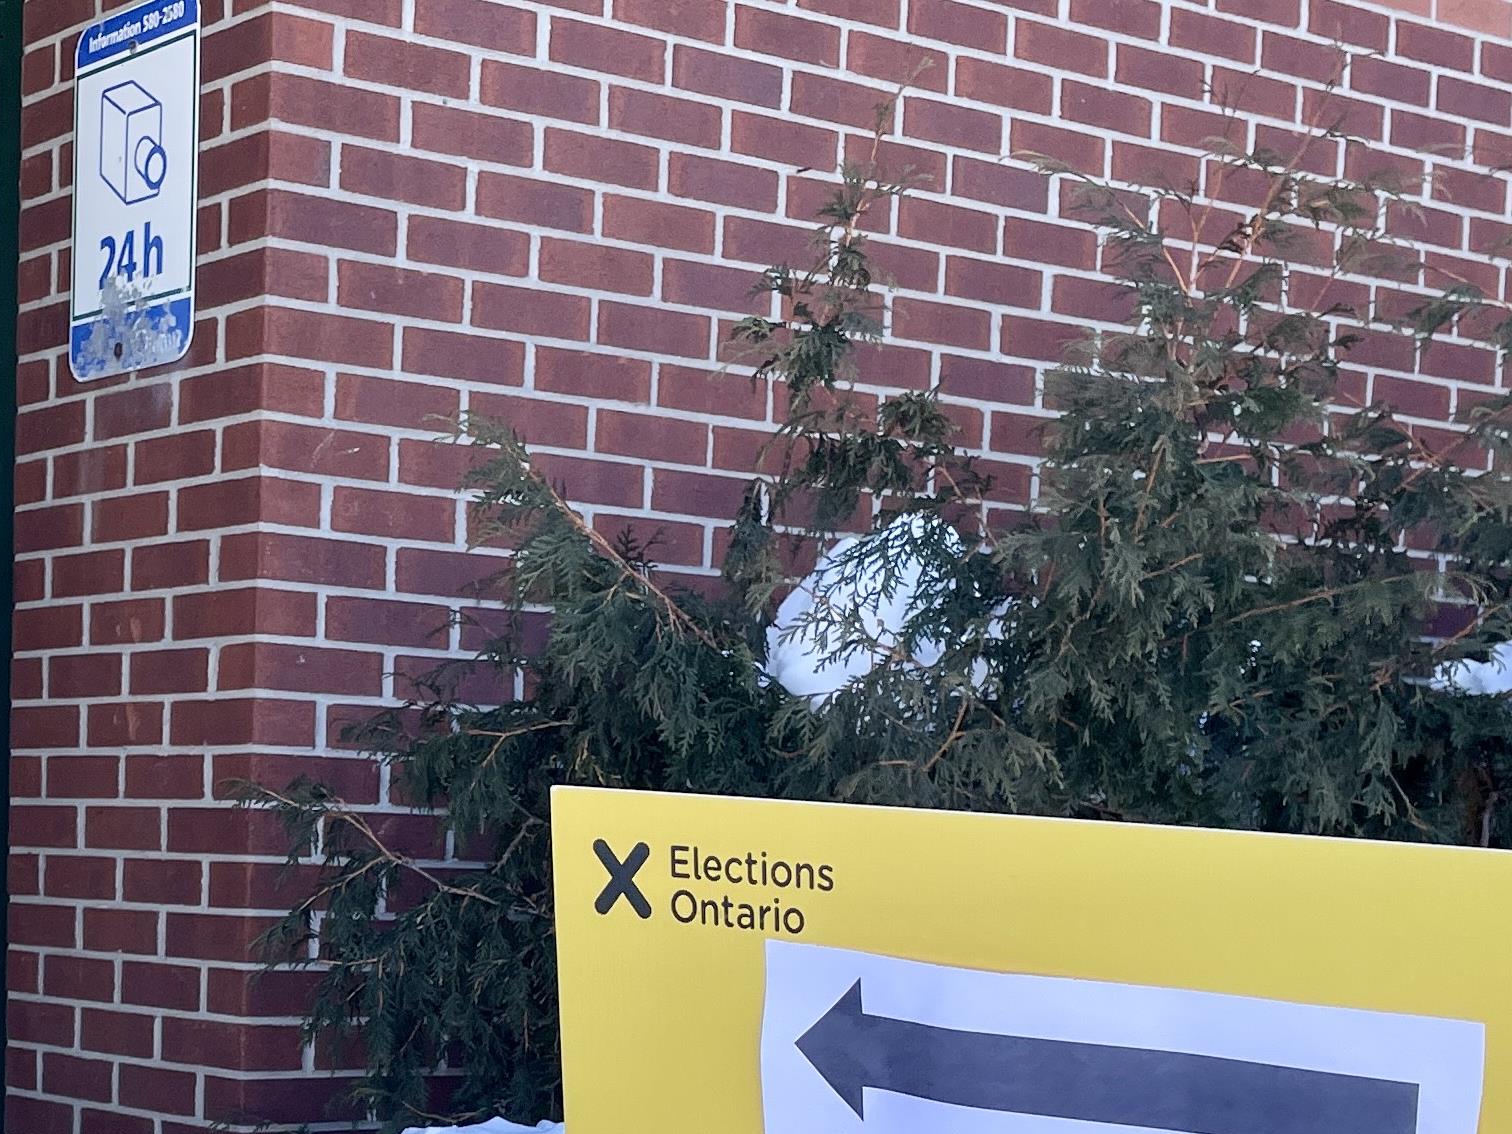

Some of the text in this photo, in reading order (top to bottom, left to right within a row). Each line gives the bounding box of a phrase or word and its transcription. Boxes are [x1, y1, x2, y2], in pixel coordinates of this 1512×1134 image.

[88, 21, 141, 53] Information
[670, 845, 834, 891] Elections
[670, 889, 805, 934] Ontario
